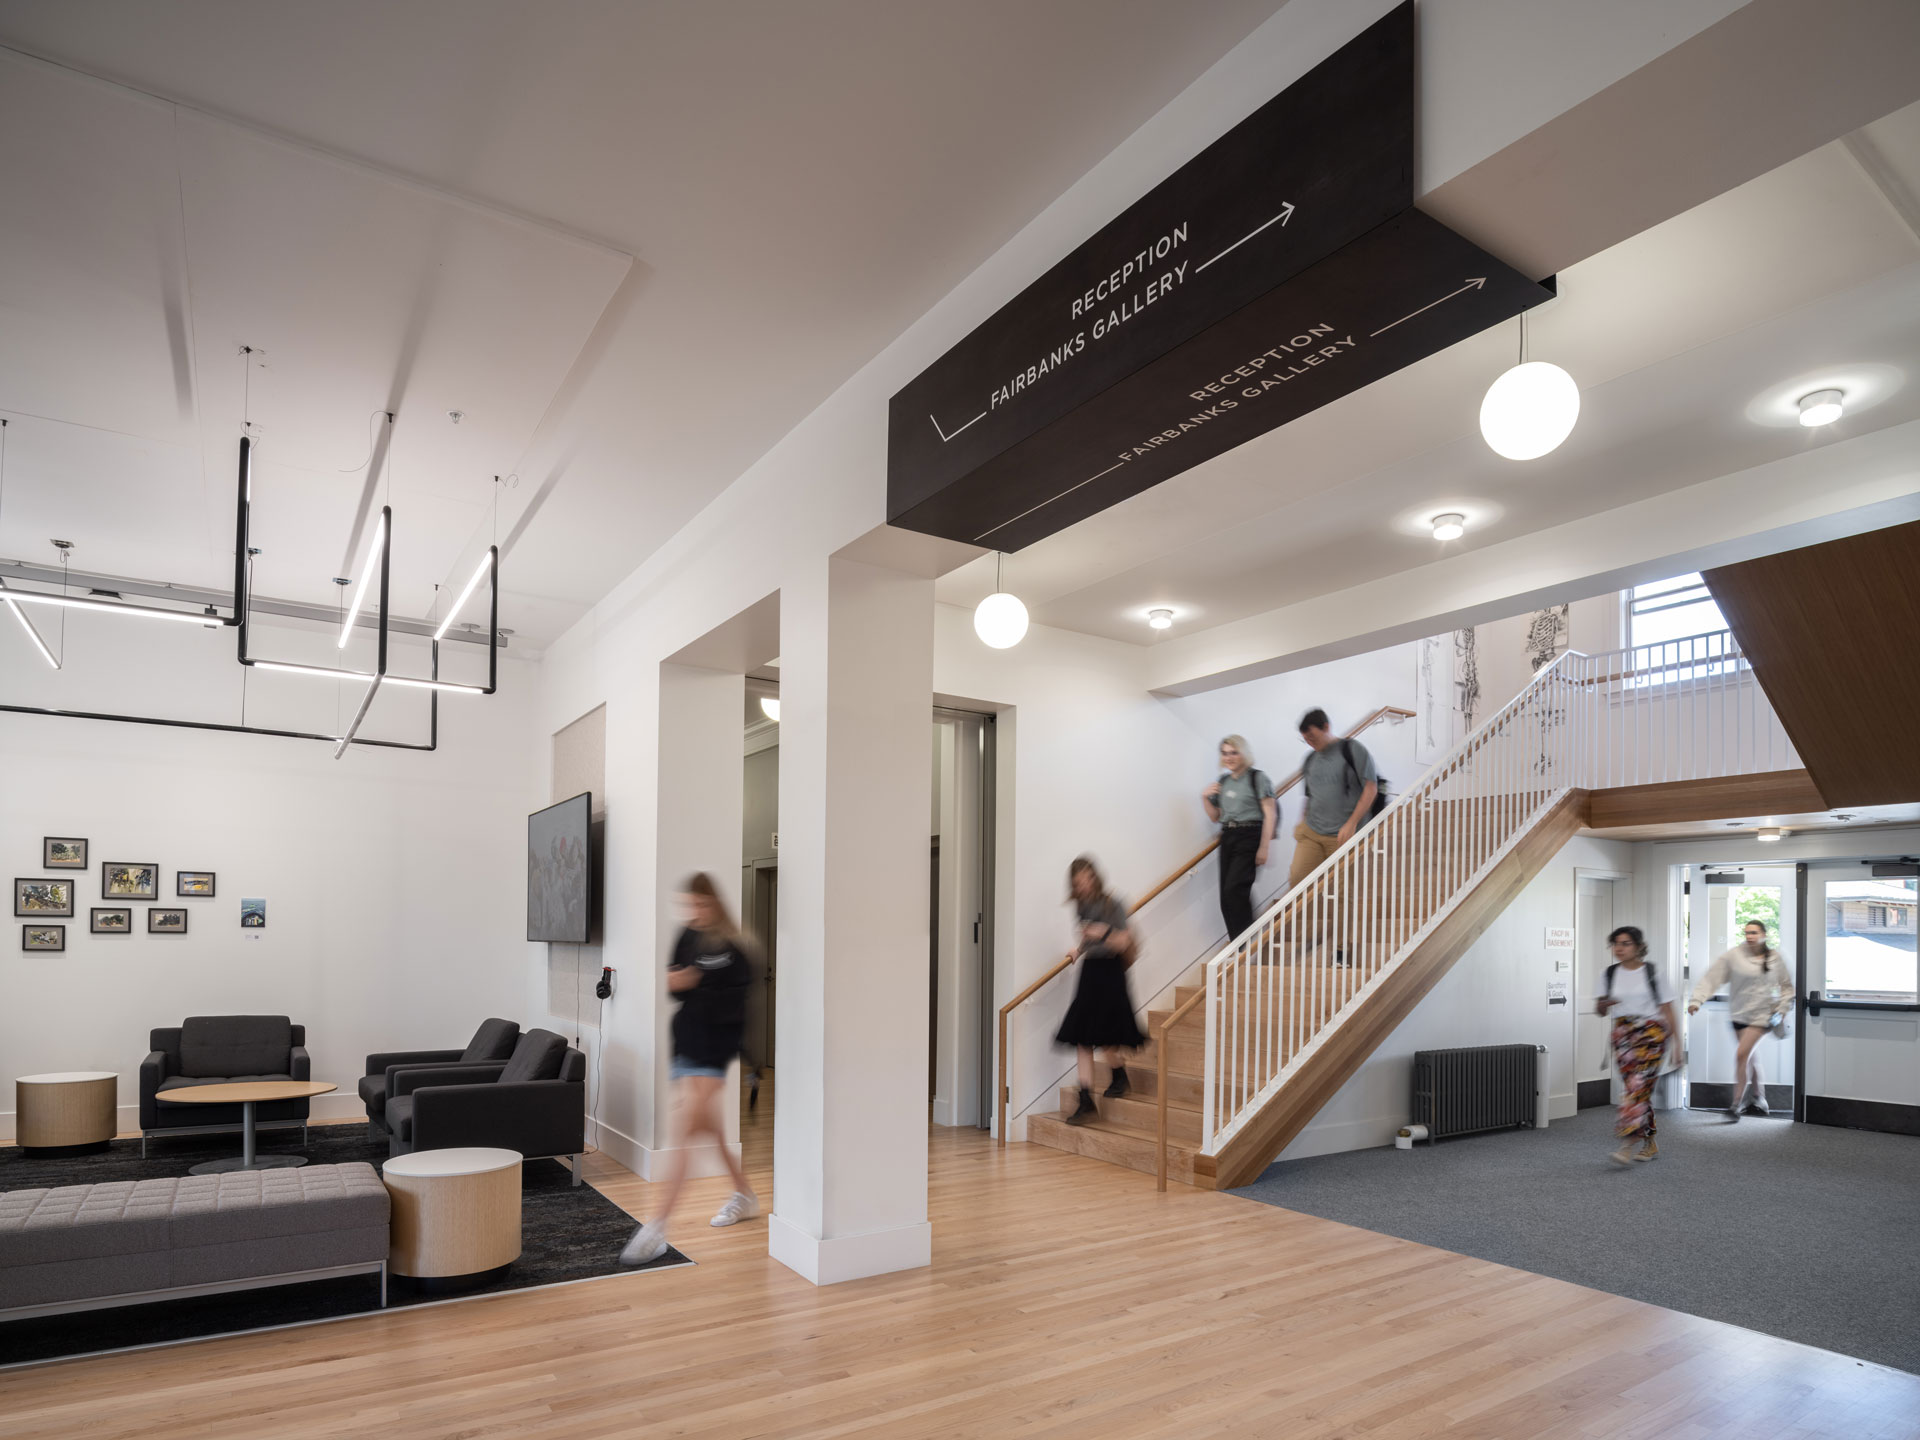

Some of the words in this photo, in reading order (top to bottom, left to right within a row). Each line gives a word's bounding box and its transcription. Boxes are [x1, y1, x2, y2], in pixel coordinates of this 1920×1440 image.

[1072, 221, 1188, 320] RECEPTION
[991, 331, 1085, 411] FAIRBANKS
[1092, 259, 1189, 341] GALLERY
[1189, 322, 1335, 401] RECEPTION
[1118, 398, 1239, 461] FAIRBANKS
[1241, 335, 1356, 398] GALLERY
[1547, 939, 1573, 947] BASEMENT
